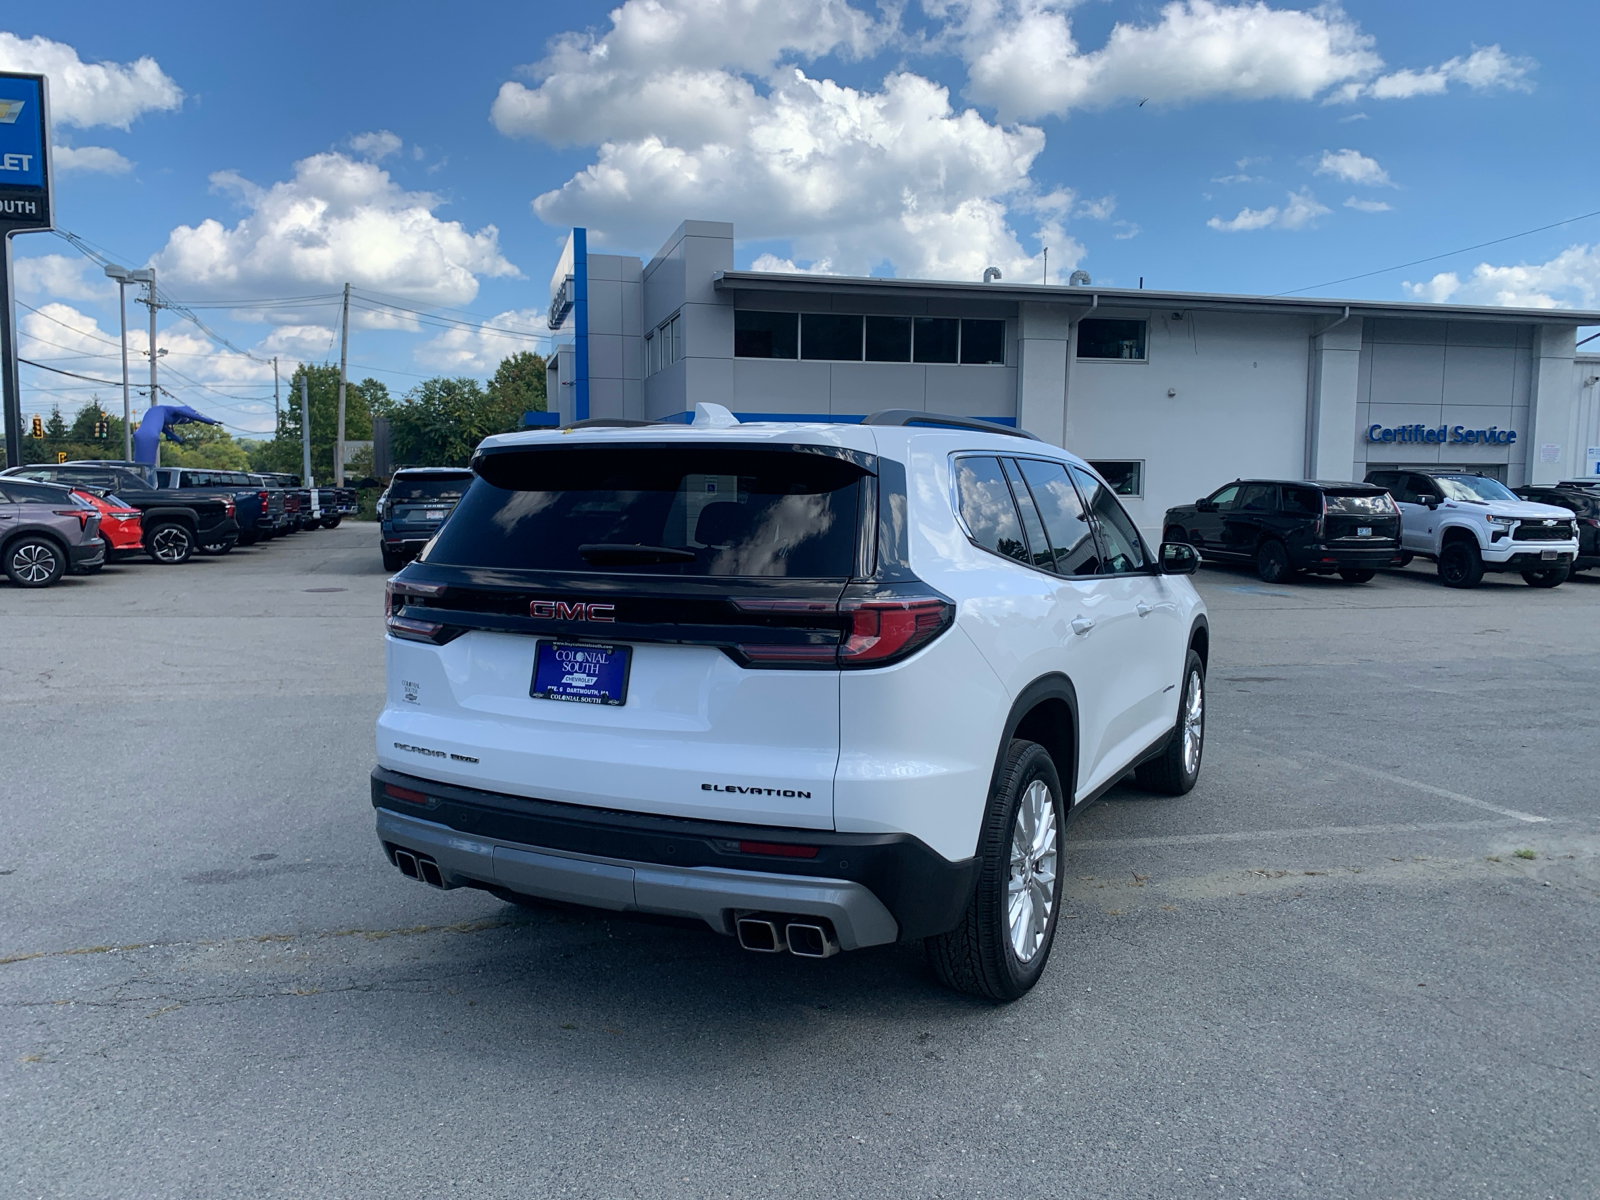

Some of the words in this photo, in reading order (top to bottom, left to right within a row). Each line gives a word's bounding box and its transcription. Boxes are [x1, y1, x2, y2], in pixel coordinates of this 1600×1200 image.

[1368, 424, 1447, 443] Certified
[1453, 425, 1517, 444] Service
[530, 600, 615, 623] GMC
[555, 650, 609, 664] COLONIAL
[562, 661, 599, 674] SOUTH
[565, 676, 594, 684] CHEVROLET
[550, 694, 580, 702] COLONIAL
[566, 687, 600, 696] DARTMOUTH,
[394, 742, 447, 759] ACADIA
[701, 783, 811, 799] ELEVATION
